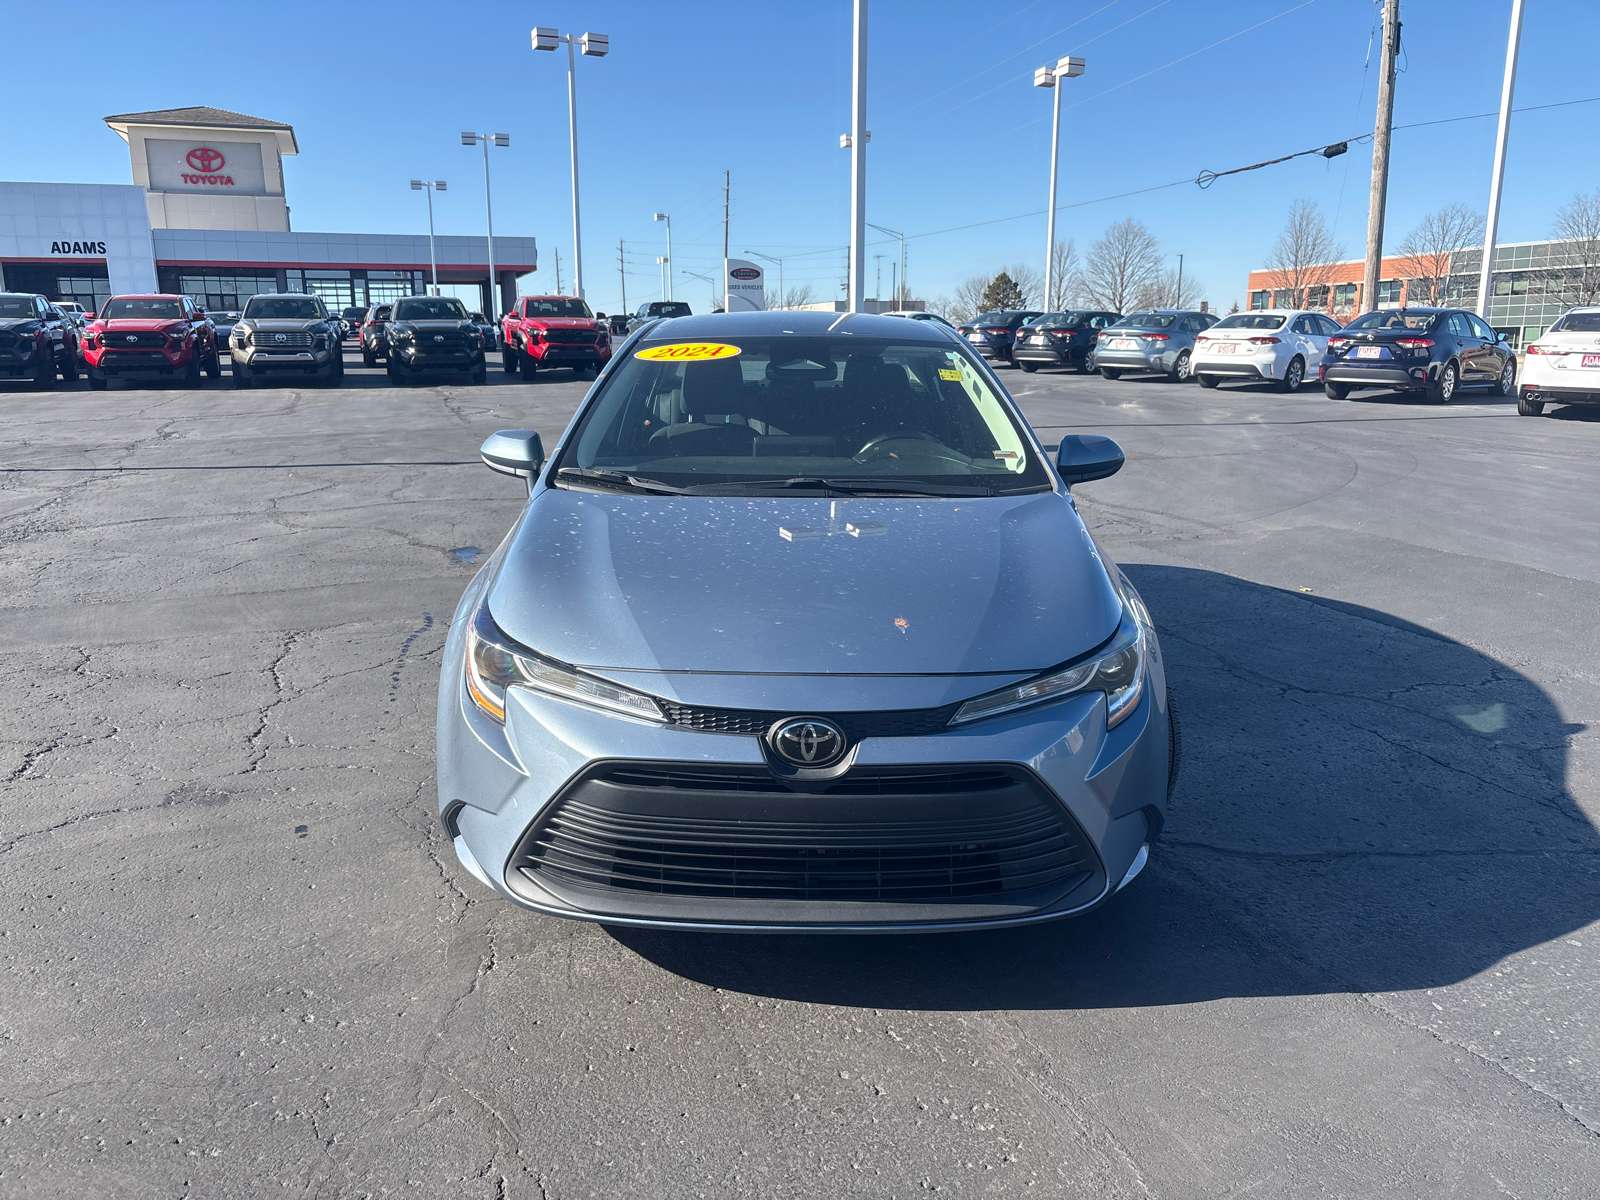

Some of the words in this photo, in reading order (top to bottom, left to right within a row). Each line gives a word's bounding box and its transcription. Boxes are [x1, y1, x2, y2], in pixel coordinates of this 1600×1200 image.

[181, 174, 235, 186] TOYOTA
[51, 241, 107, 255] ADAMS
[651, 346, 724, 358] 2024
[1582, 355, 1600, 367] ADA
